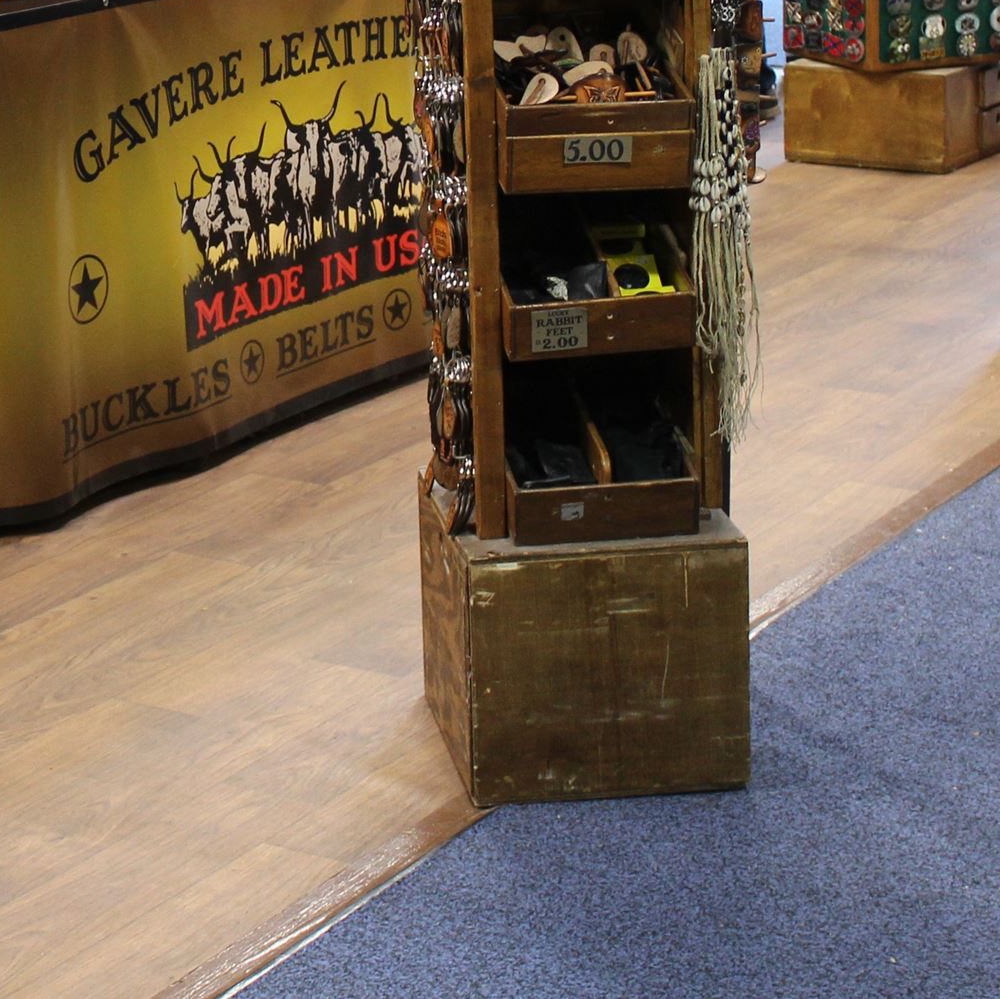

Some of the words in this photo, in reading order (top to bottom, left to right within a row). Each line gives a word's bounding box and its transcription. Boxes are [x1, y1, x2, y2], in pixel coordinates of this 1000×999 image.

[72, 49, 245, 183] GAVERE
[259, 14, 417, 87] LEATHE
[566, 138, 625, 162] 5.00
[194, 264, 306, 339] MADE
[320, 247, 359, 288] IN
[372, 229, 422, 272] US
[536, 316, 583, 328] RABBIT
[546, 327, 573, 336] FEET
[543, 336, 578, 349] 2.00
[62, 358, 232, 455] BUCKLES
[276, 304, 376, 371] BELTS
